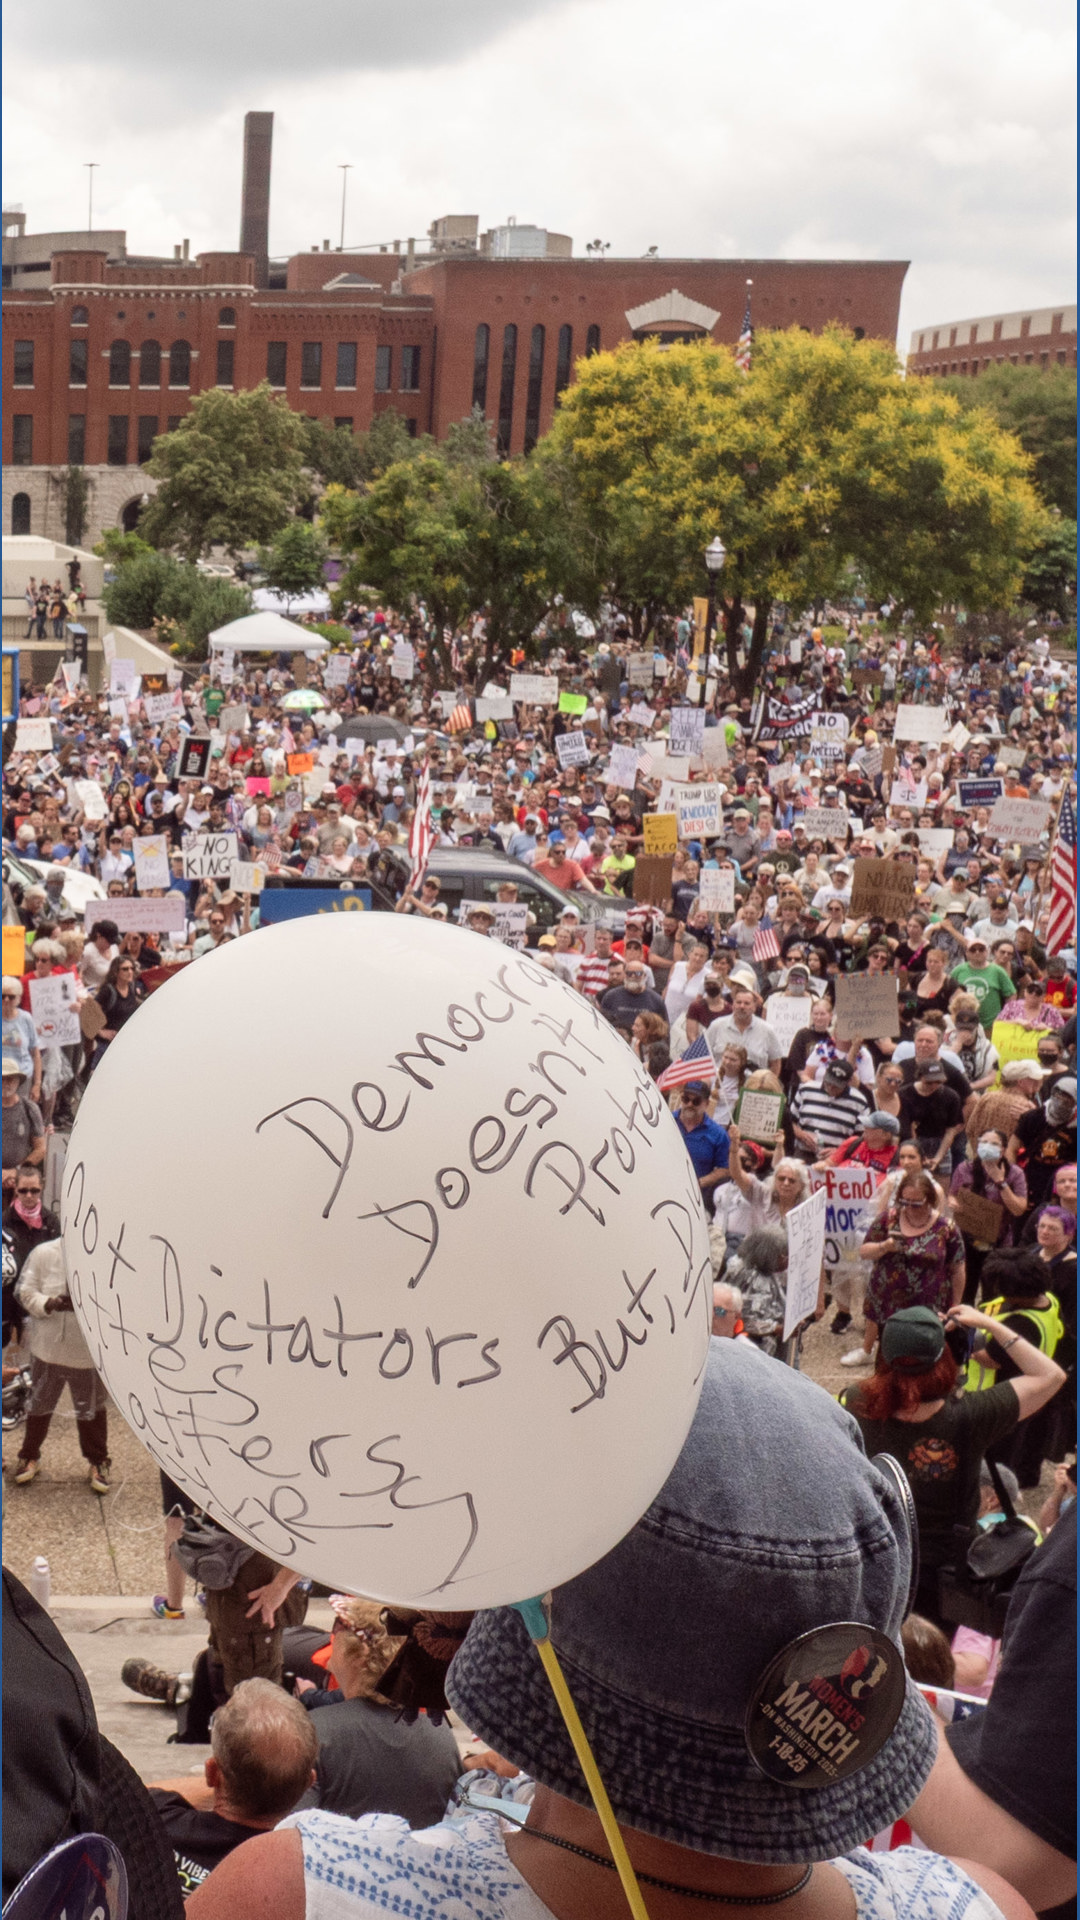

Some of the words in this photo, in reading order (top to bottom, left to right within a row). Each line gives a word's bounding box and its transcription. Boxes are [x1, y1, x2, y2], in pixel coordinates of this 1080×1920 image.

[817, 714, 837, 727] NO
[811, 745, 844, 757] AMERICA
[680, 790, 701, 801] TRUMP
[704, 789, 717, 801] LIES
[680, 804, 718, 821] DEMOCRACY
[683, 821, 704, 834] DIES!
[203, 835, 228, 856] NO
[256, 958, 558, 1219] Democra
[147, 1233, 501, 1389] Dictators
[808, 1674, 866, 1732] WOMEN'S
[774, 1680, 860, 1765] MARCH
[774, 1714, 820, 1760] WASHINGTON
[768, 1734, 809, 1774] 1-18-25
